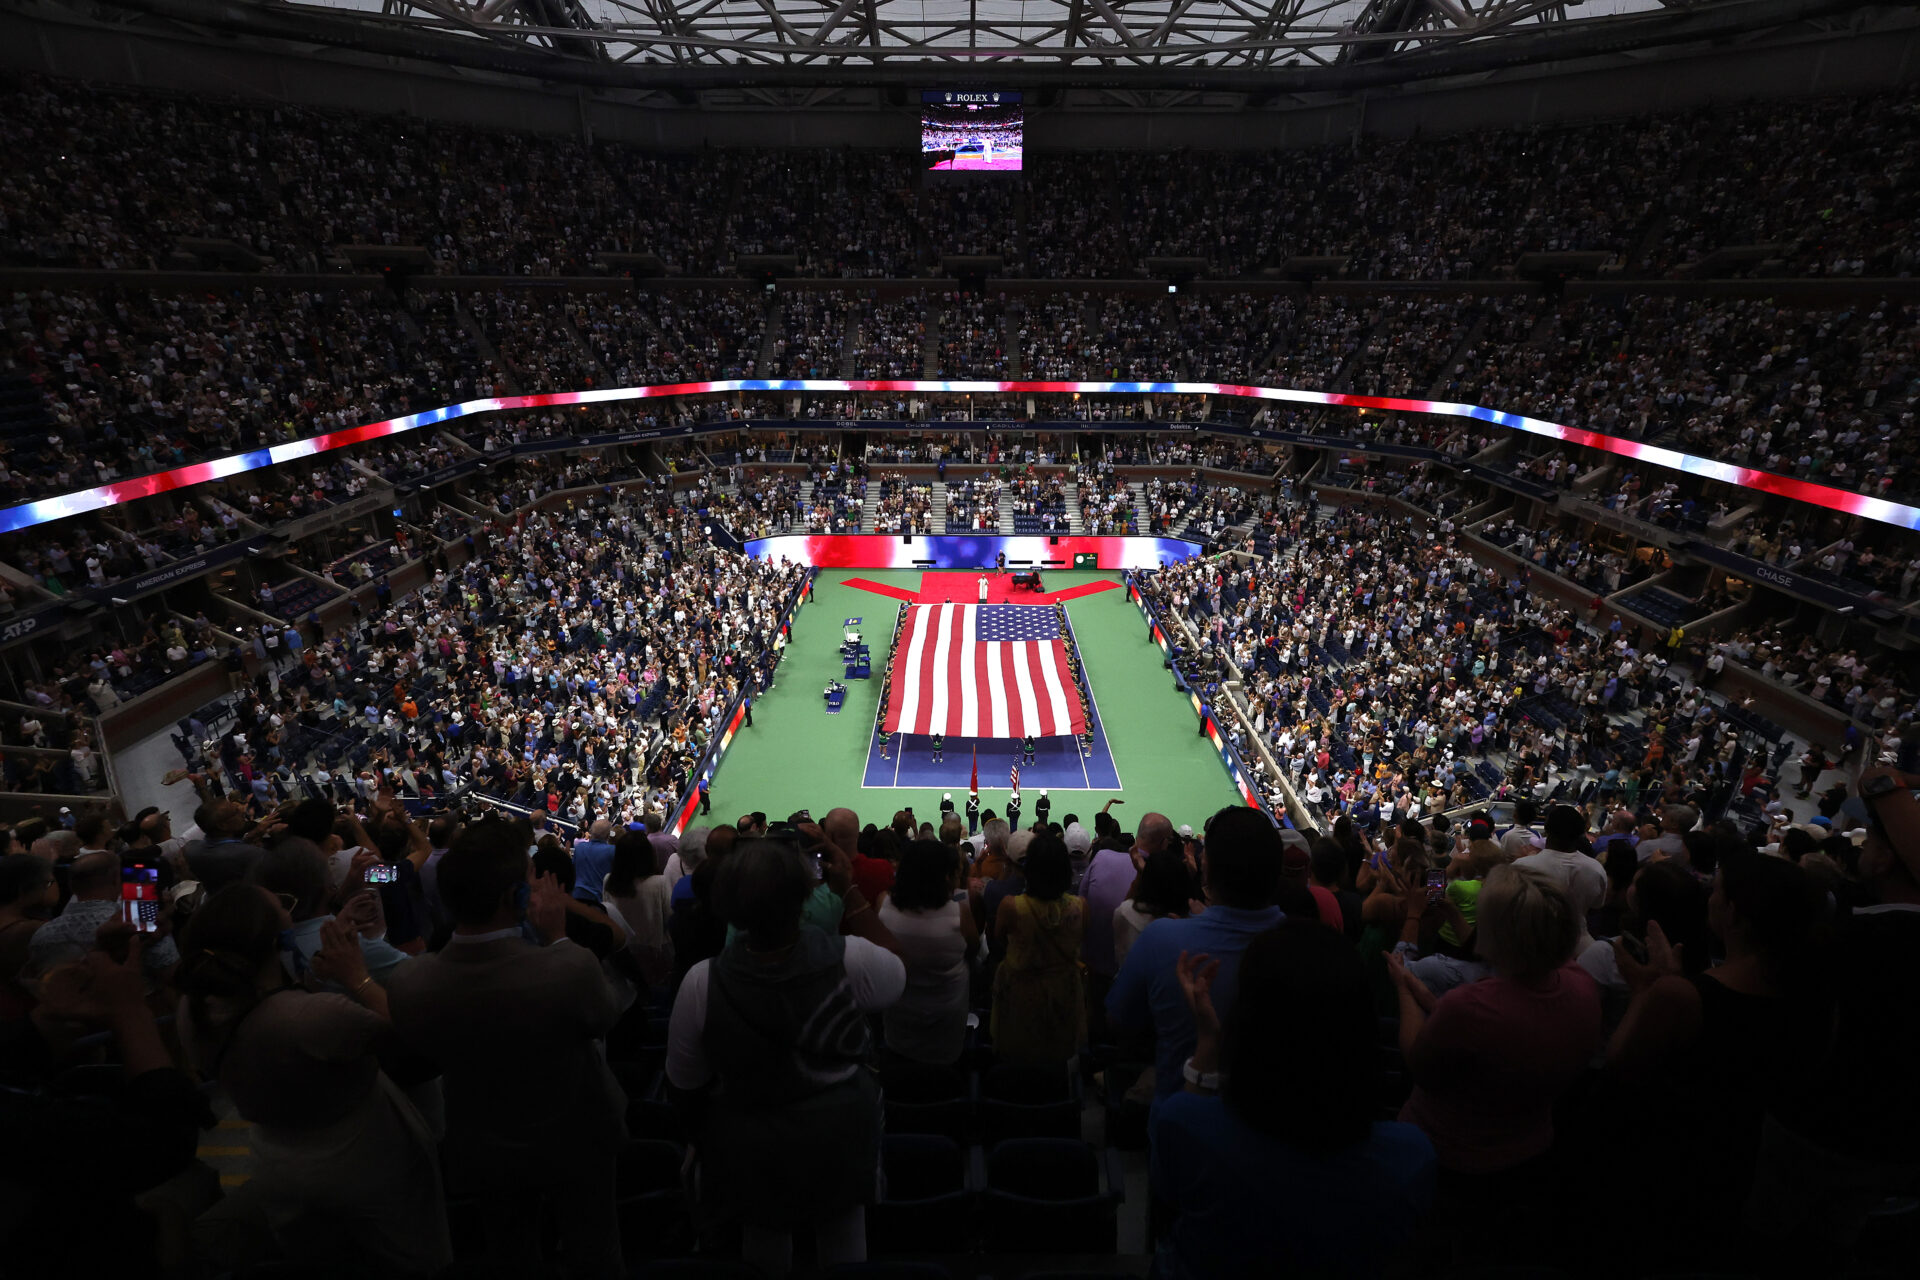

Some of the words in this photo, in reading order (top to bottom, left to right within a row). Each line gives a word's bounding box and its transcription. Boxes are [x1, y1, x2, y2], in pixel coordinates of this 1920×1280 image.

[957, 94, 988, 102] ROLEX
[136, 571, 175, 589] AMERICAN
[175, 559, 207, 576] EXPRESS
[1756, 567, 1793, 587] CHASE
[2, 618, 37, 641] ATP
